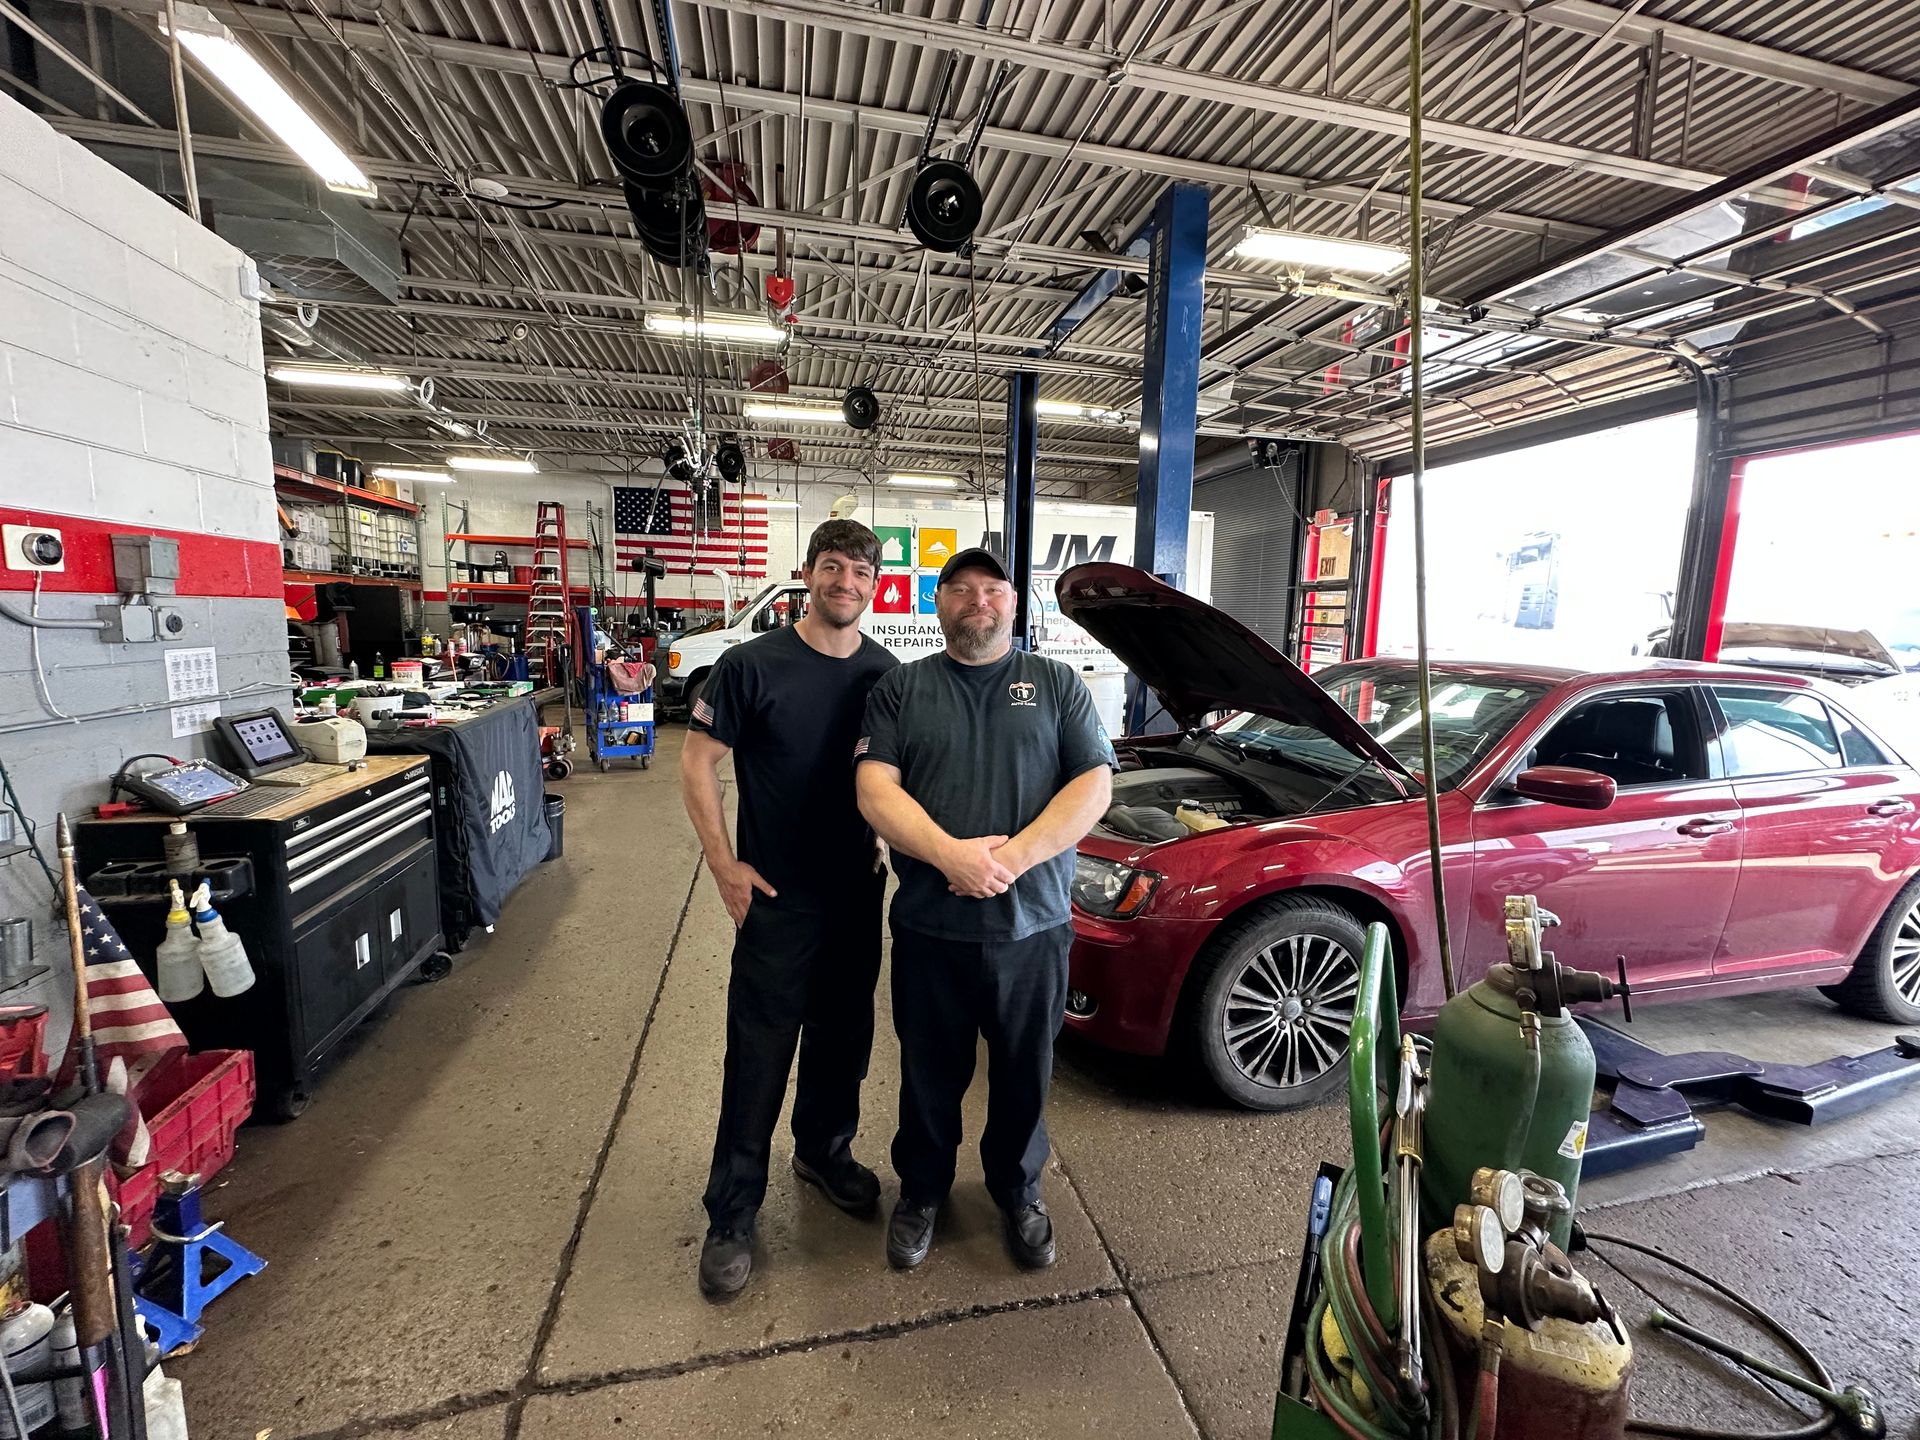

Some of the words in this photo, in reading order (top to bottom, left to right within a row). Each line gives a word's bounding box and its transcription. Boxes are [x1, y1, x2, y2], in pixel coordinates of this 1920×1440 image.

[1320, 557, 1336, 576] EXIT
[1035, 616, 1071, 627] Emerg
[872, 625, 944, 635] INSURANC
[884, 638, 944, 647] REPAIRS
[491, 770, 515, 820] MAC
[1203, 801, 1242, 812] EMI
[490, 802, 516, 834] TOOLS
